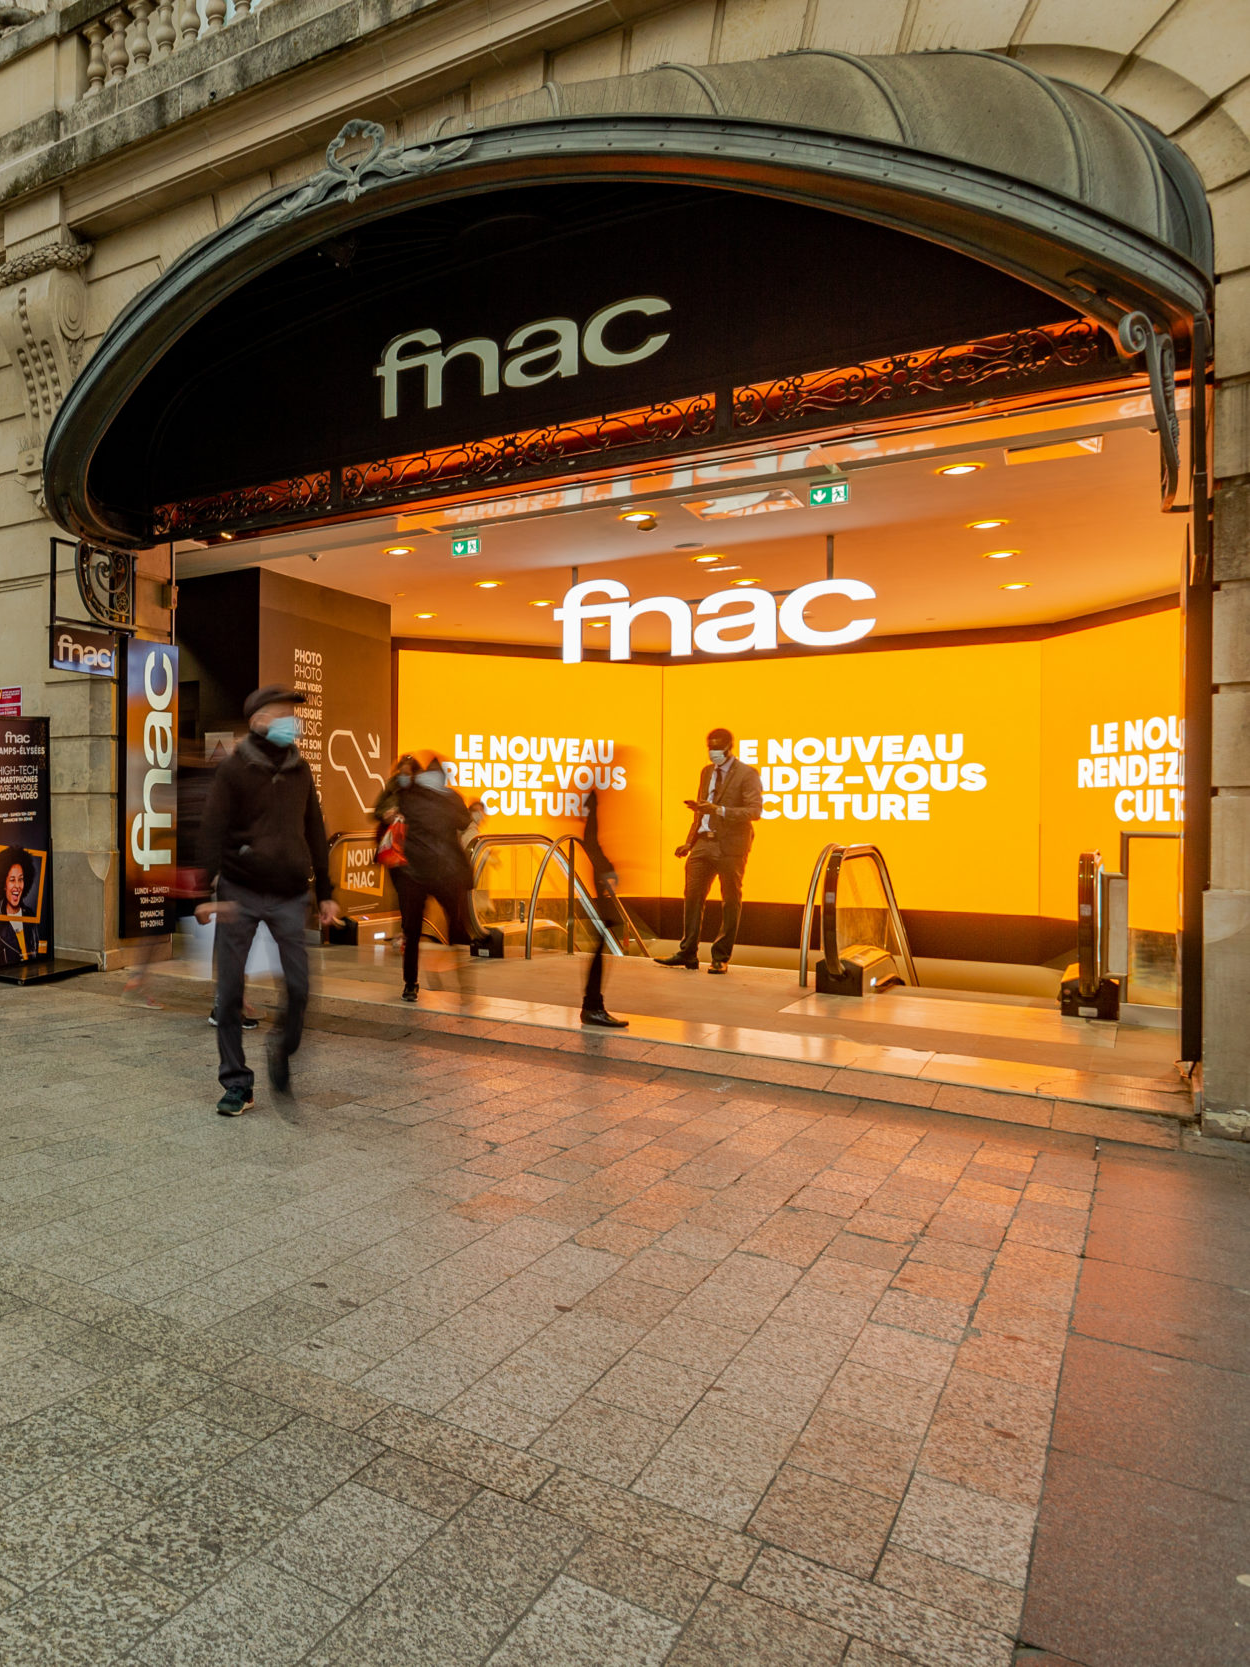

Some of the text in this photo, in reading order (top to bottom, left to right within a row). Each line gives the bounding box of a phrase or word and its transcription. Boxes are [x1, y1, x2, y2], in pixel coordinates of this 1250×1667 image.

[375, 296, 671, 419] fnac
[553, 579, 877, 664] fnac
[58, 634, 112, 668] fnac
[294, 648, 322, 666] PHOTO
[294, 664, 322, 681] PHOTO
[294, 680, 306, 690] JEUX
[294, 706, 322, 720] MUSIQUE
[294, 718, 322, 736] MUSIC
[5, 731, 30, 744] fnac
[309, 739, 322, 750] SON
[1090, 715, 1185, 754] LE NOU
[131, 651, 173, 871] fnac
[305, 751, 322, 761] SOUND
[454, 734, 614, 764] LE NOUVEAU
[738, 733, 964, 765] E NOUVEAU
[441, 761, 627, 791] RENDEZ-VOUS
[1078, 751, 1182, 788] RENDEZ
[760, 793, 930, 821] CULTURE
[1114, 788, 1183, 822] CULT
[347, 848, 377, 868] NOUV
[347, 870, 375, 890] FNAC
